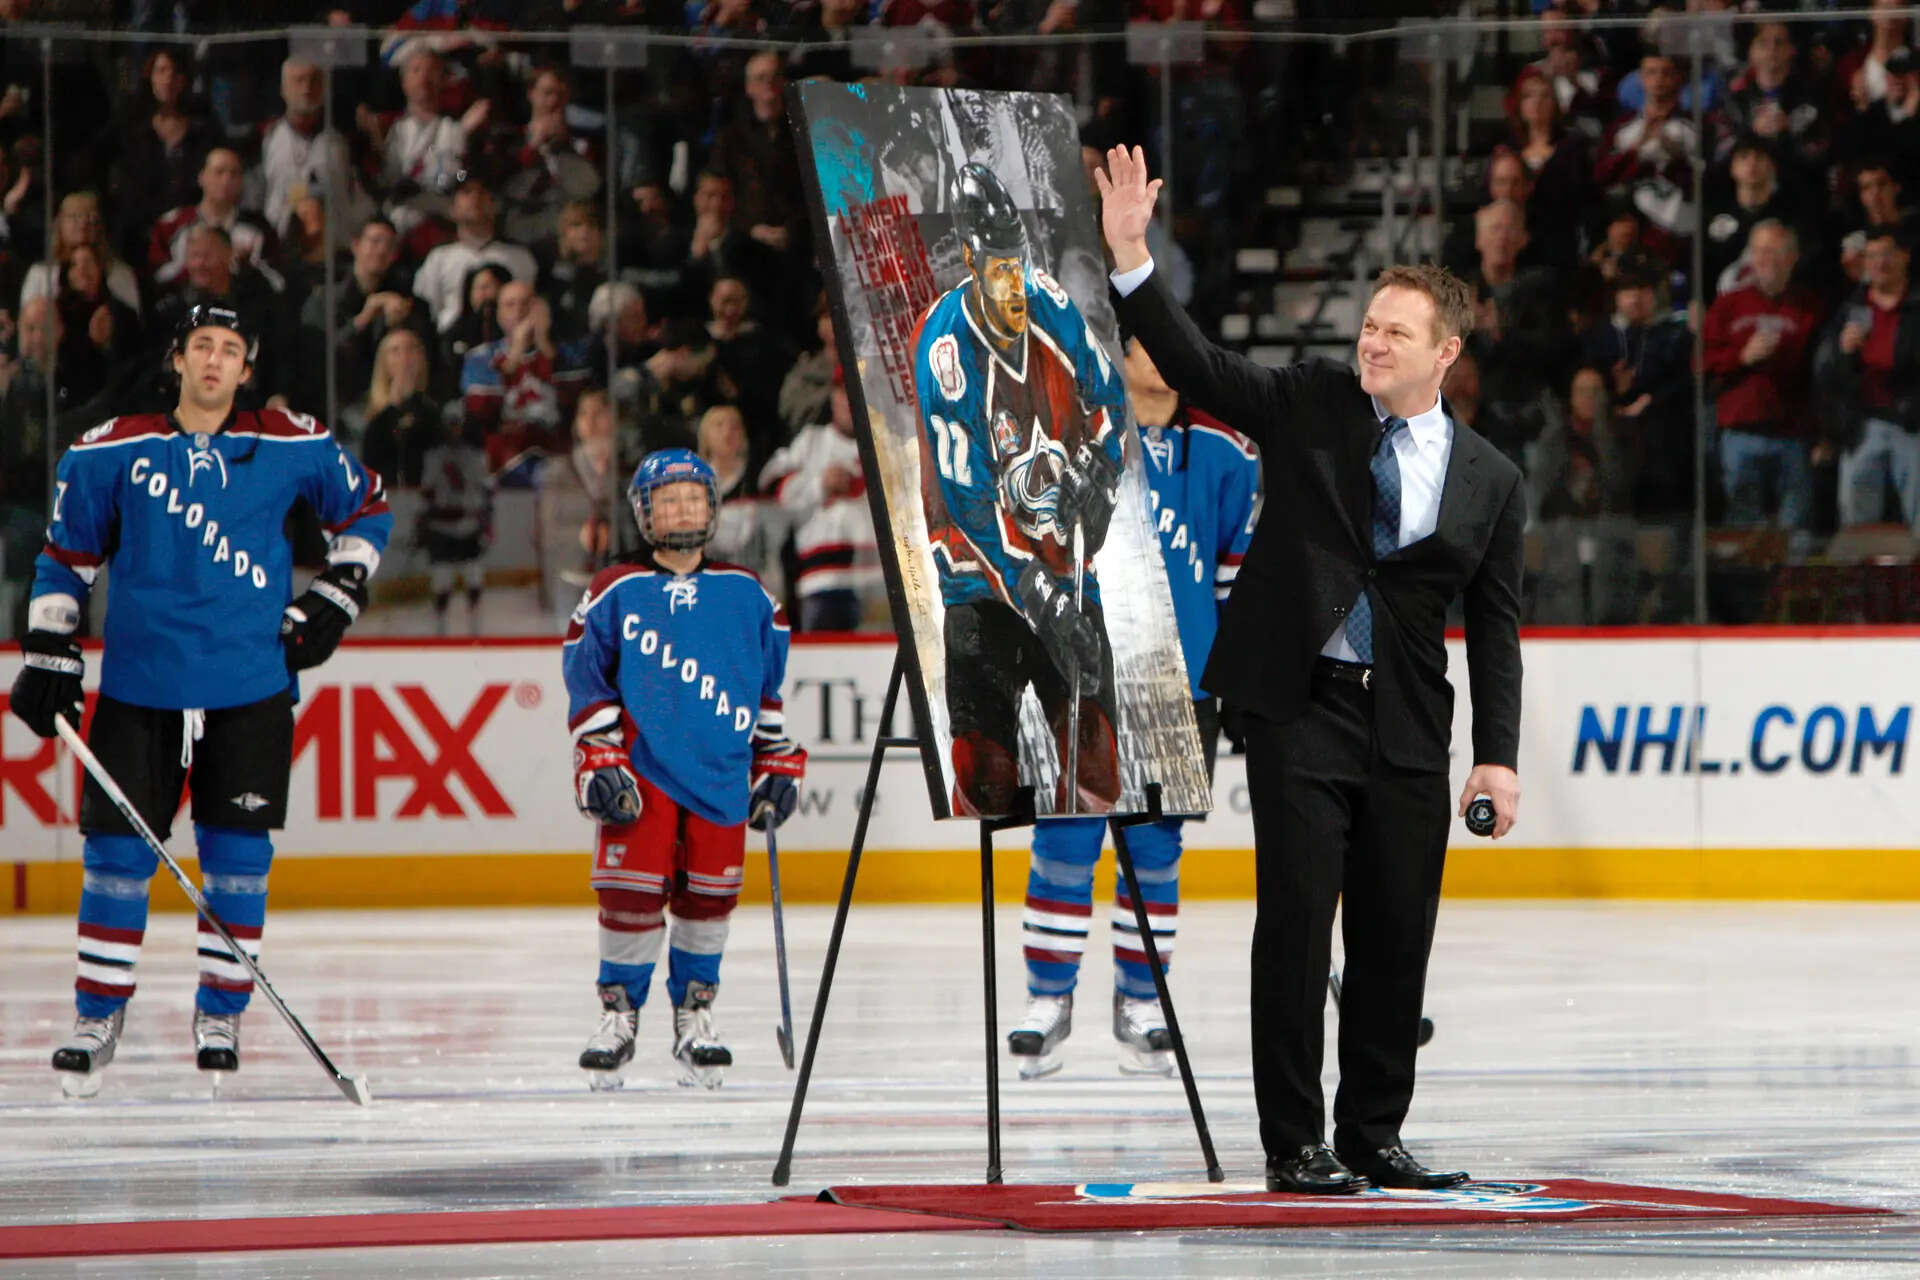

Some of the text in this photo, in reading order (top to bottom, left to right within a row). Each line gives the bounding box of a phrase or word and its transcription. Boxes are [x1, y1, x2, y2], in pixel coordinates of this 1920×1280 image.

[836, 194, 910, 235] LEMIEUX
[130, 457, 267, 589] COLORADO
[1572, 705, 1912, 774] NHL.COM
